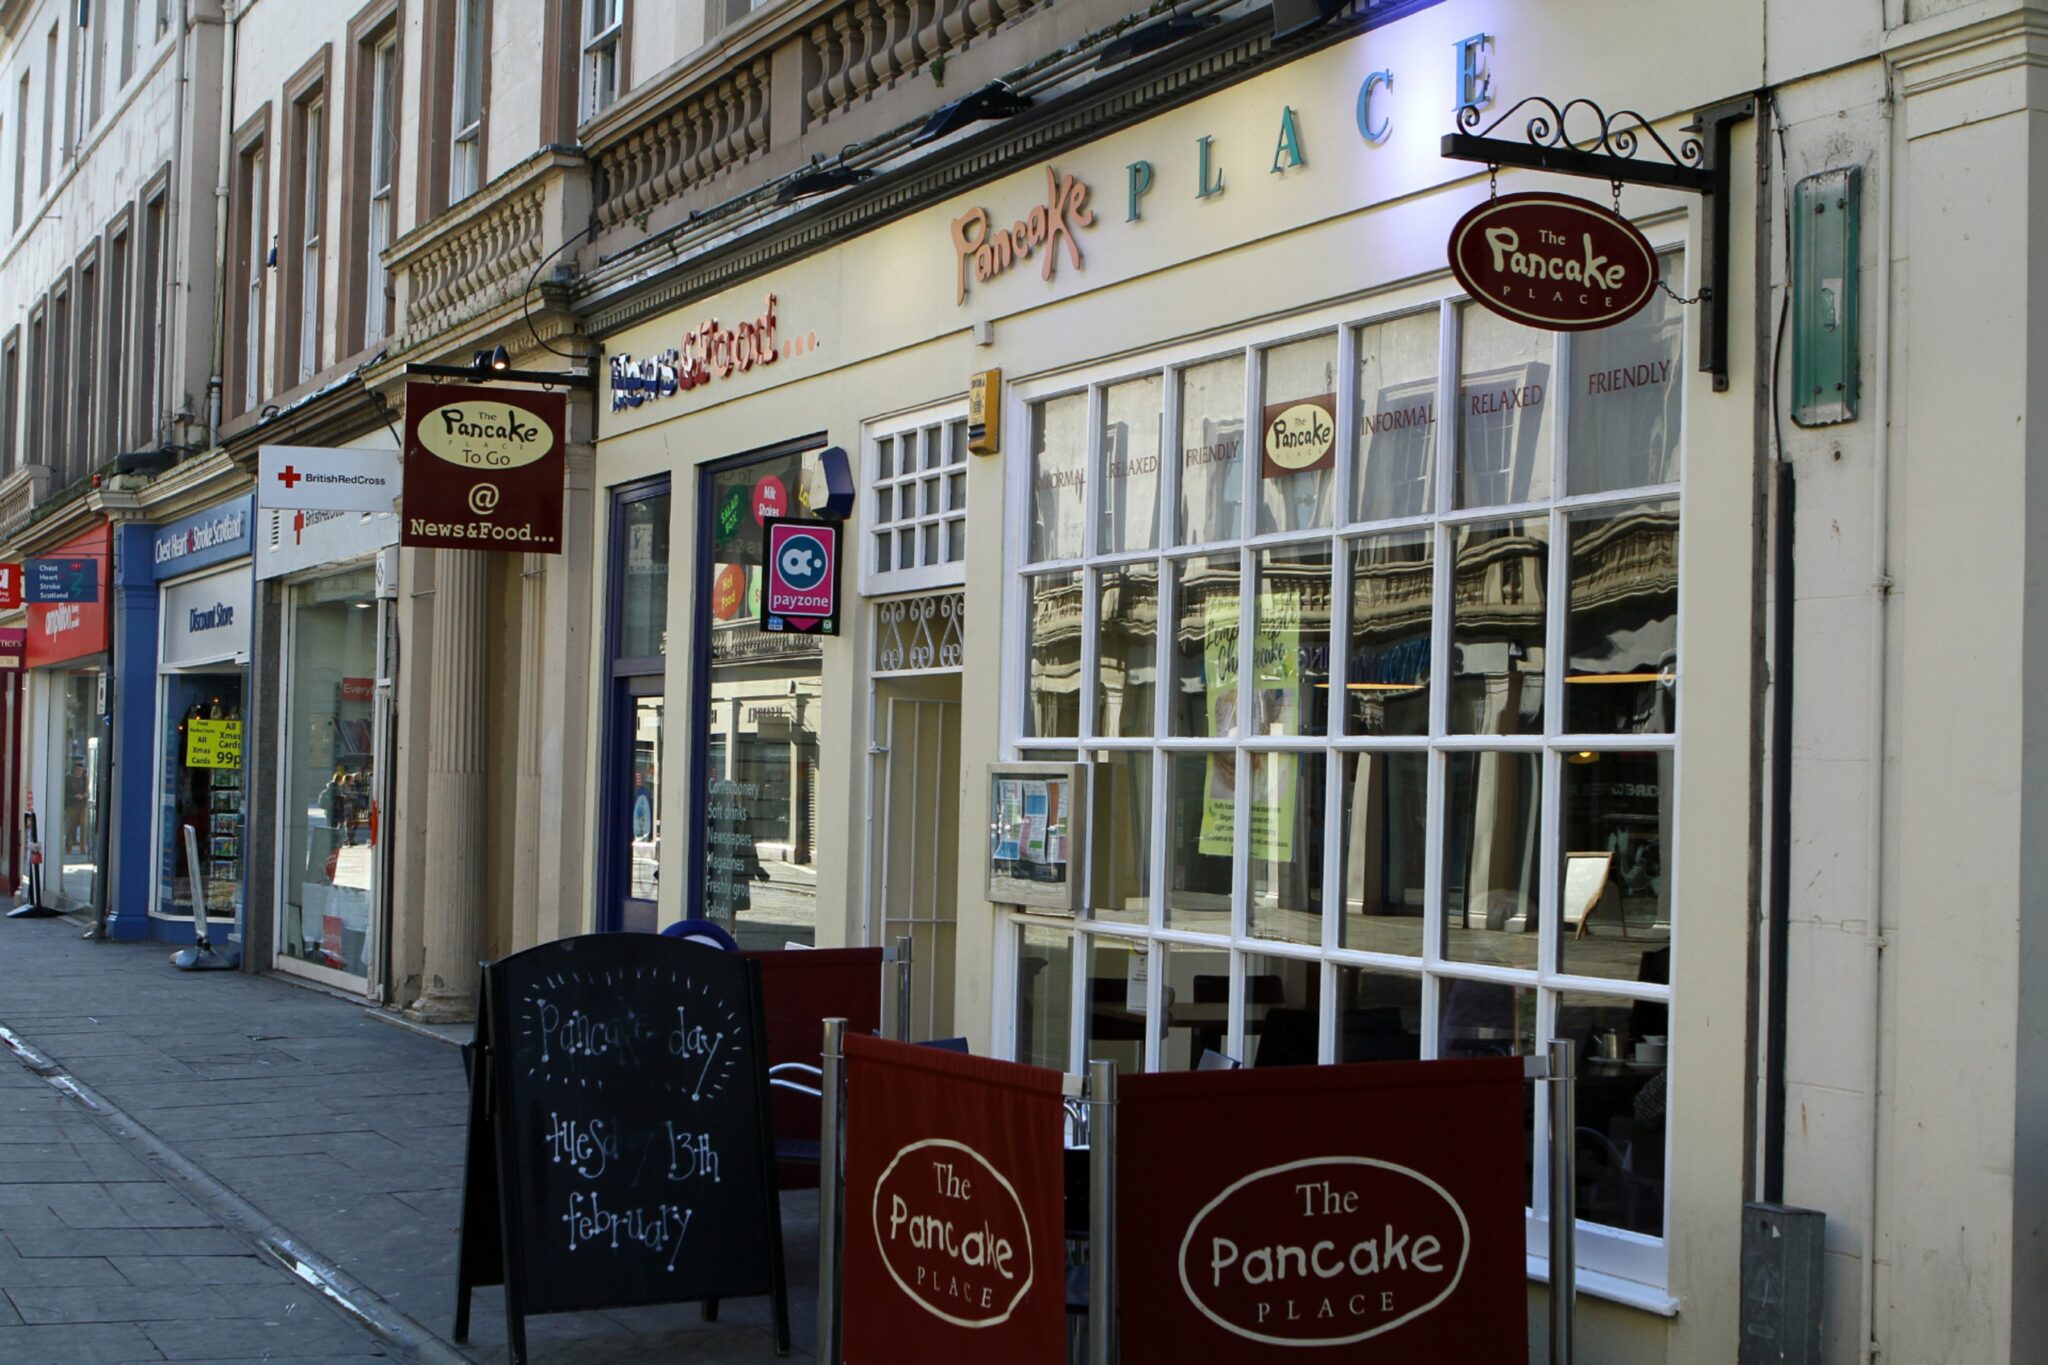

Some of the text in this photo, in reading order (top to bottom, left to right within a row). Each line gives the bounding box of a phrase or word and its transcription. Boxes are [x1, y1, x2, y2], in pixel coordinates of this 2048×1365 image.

[951, 32, 1496, 306] Pancake PLACE
[1538, 229, 1566, 246] The
[1485, 226, 1626, 290] Pancake
[1503, 285, 1613, 308] PLACE
[1361, 359, 1672, 436] INFORMAL RELAXED FRIENDLY
[441, 409, 538, 443] Pancake
[479, 411, 498, 421] The
[1273, 410, 1331, 449] Pancake
[448, 439, 525, 451] PLACE
[462, 449, 511, 466] To Go
[1108, 455, 1157, 480] RELAXED
[1185, 439, 1240, 468] FRIENDLY
[305, 473, 386, 486] BritishRedCross
[468, 482, 500, 515] @
[156, 510, 242, 565] Chest Heart Stroke Scotland
[39, 564, 58, 572] Chest
[40, 592, 69, 600] Scotland
[773, 593, 829, 610] payzone
[189, 602, 234, 634] Discount Store
[219, 732, 241, 740] Xmas
[225, 722, 237, 731] All
[218, 740, 241, 749] Cards
[216, 751, 241, 768] 99p
[707, 802, 748, 821] Soft drinks
[706, 826, 752, 849] Newspapers
[705, 900, 729, 919] Salads
[668, 1005, 724, 1101] day
[932, 1161, 972, 1200] The
[1295, 1180, 1360, 1217] The
[889, 1193, 1015, 1280] Pancake
[1211, 1223, 1444, 1288] Pancake
[917, 1265, 993, 1309] PLACE
[1257, 1291, 1395, 1323] PLACE
